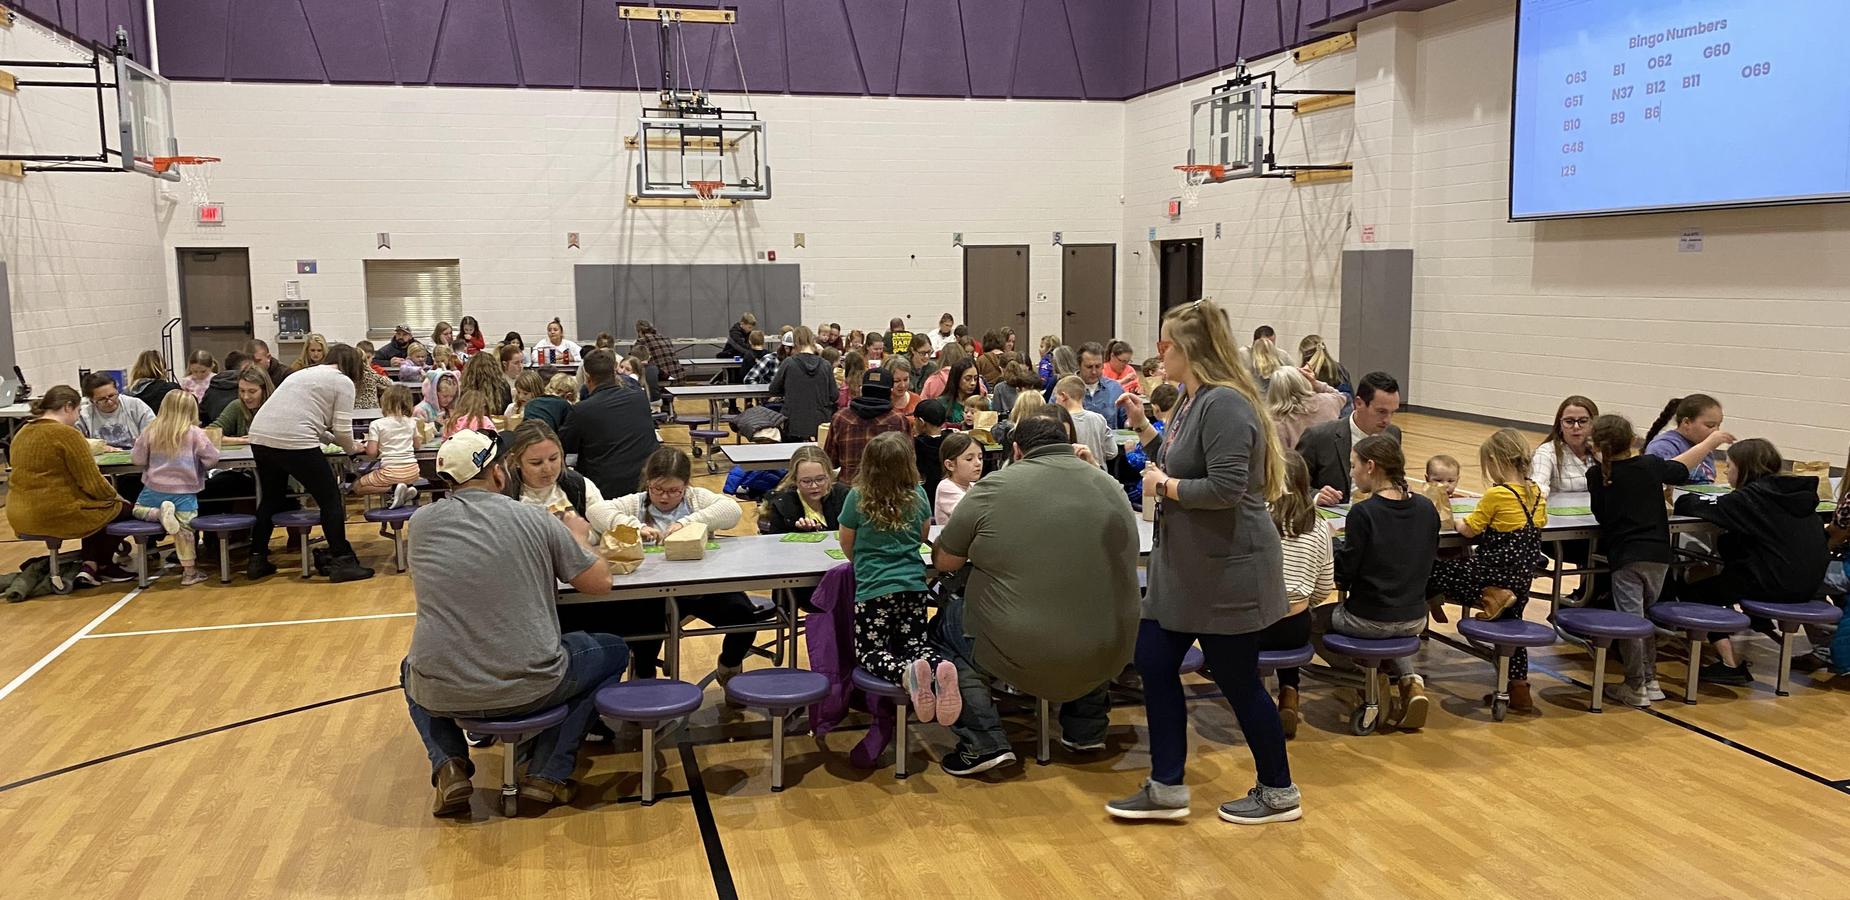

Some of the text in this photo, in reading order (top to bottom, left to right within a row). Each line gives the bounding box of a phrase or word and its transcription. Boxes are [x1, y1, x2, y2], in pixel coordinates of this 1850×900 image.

[1629, 19, 1728, 49] Bingo Numbers
[1565, 42, 1731, 85] O63 B1 O62 G60
[1564, 61, 1771, 108] G51 N37 B12 B11 O69
[1563, 106, 1660, 132] B10 B9 B6
[1561, 141, 1584, 154] G48
[1560, 164, 1576, 177] I29
